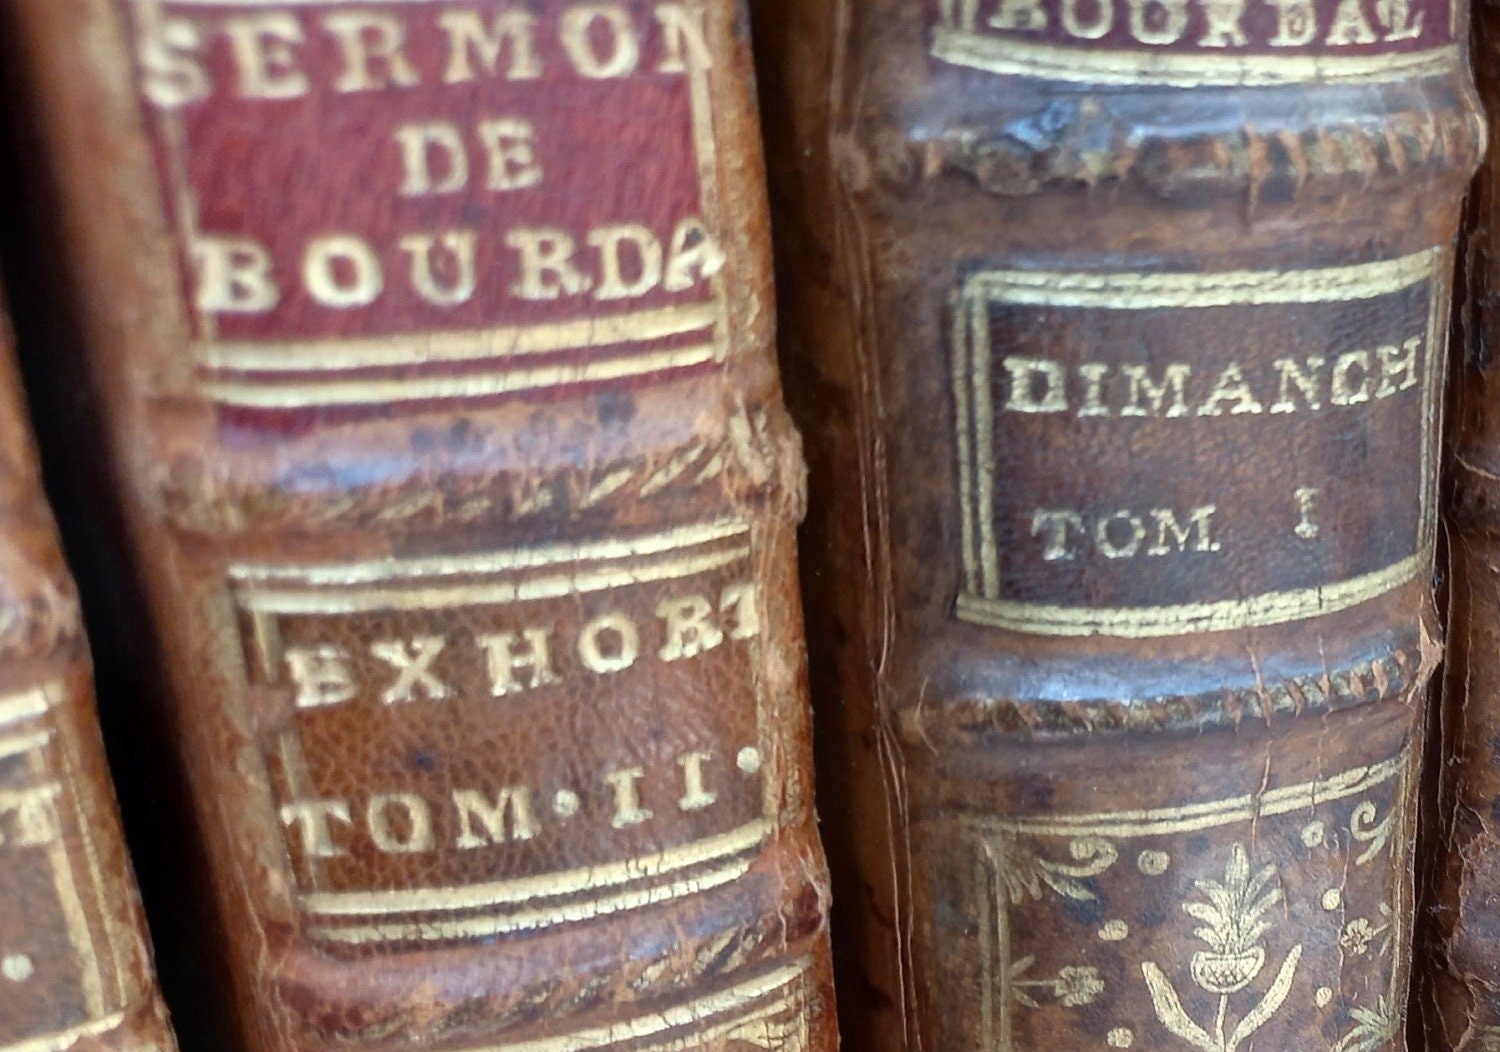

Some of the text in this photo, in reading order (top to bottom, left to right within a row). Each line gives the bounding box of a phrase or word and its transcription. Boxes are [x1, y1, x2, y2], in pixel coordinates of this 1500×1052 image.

[396, 118, 543, 197] DE
[196, 217, 726, 313] BOURDA
[1003, 336, 1424, 418] DIMANCH
[1293, 485, 1320, 539] I
[285, 583, 762, 708] EXHORT
